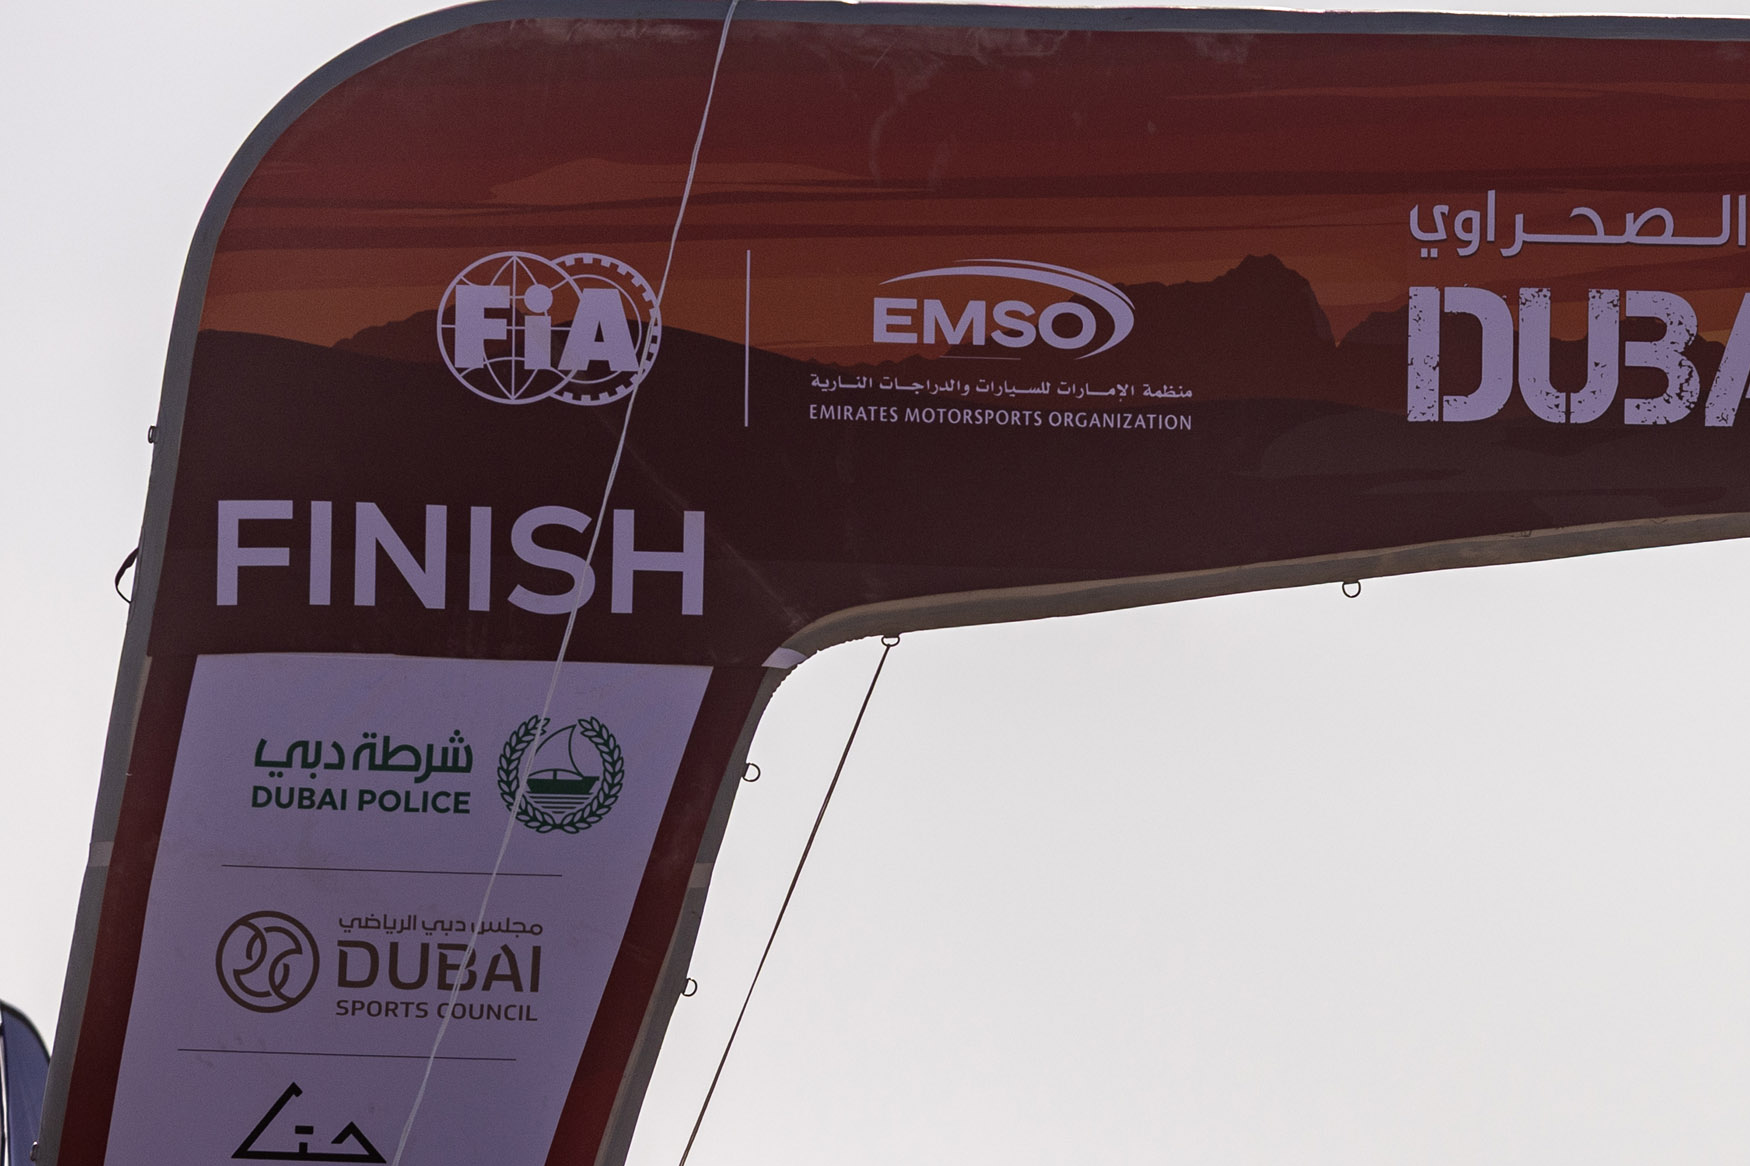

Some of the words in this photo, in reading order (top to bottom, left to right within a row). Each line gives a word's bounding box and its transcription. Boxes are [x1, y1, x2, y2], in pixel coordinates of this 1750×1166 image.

[1410, 190, 1746, 257] الصحراوي
[873, 297, 1097, 349] EMSO
[811, 374, 872, 391] النارية
[880, 377, 970, 396] والدراجات
[976, 379, 1050, 397] للسيارات
[1143, 384, 1192, 398] منظمة
[810, 404, 898, 422] EMIRATES
[905, 408, 1042, 426] MOTORSPORTS
[1049, 412, 1191, 430] ORGANIZATION
[216, 499, 706, 616] FINISH
[255, 739, 345, 779] دبي
[352, 730, 473, 783] شرطة
[252, 786, 347, 810] DUBAI
[358, 789, 470, 814] POLICE
[339, 914, 417, 934] الرياضي
[422, 920, 466, 936] دبي
[471, 918, 543, 938] مجلس
[337, 940, 541, 992] DUBAI
[336, 1000, 428, 1018] SPORTS
[437, 1003, 537, 1021] COUNCIL
